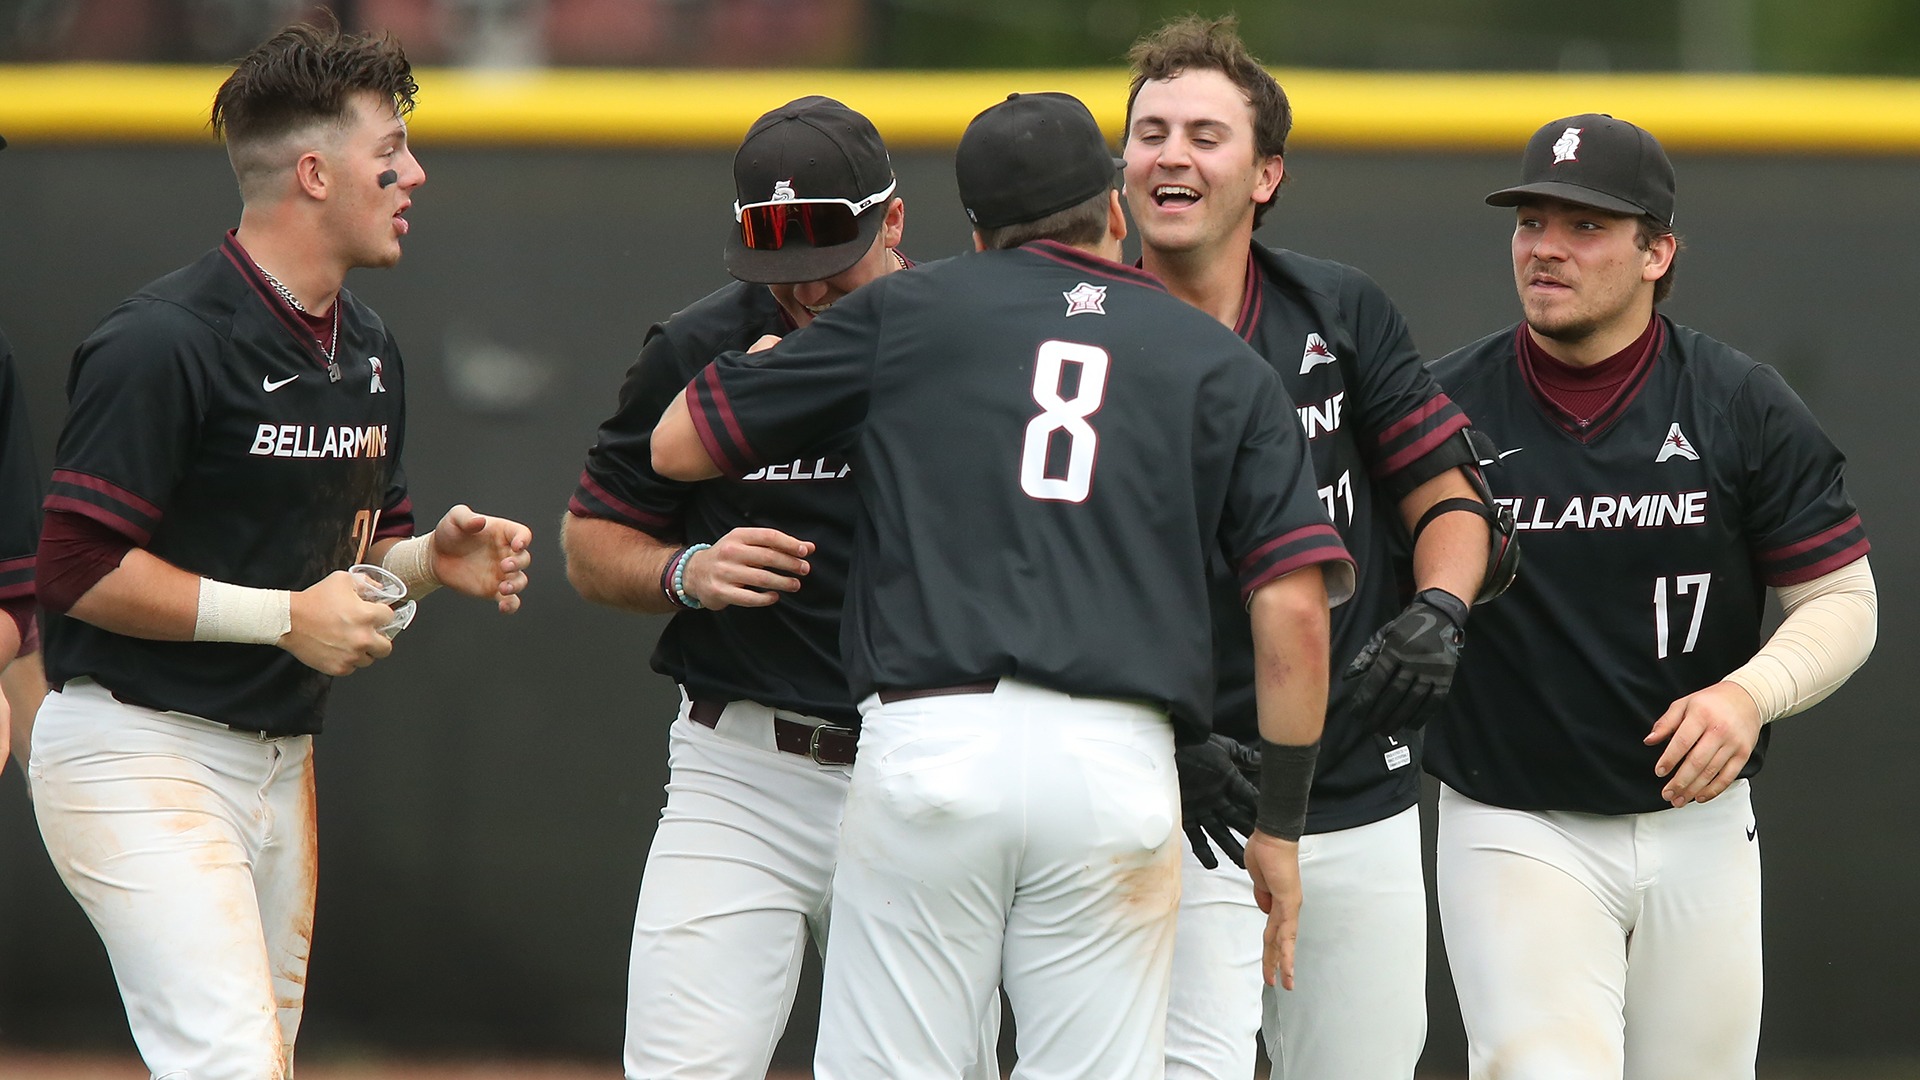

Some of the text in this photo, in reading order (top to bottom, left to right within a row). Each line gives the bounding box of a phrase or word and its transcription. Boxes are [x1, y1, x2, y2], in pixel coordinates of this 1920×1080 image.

[249, 423, 388, 458] BELLARMINE
[1019, 338, 1111, 504] 8
[1296, 390, 1345, 439] INE
[1317, 469, 1355, 528] 77
[351, 508, 382, 566] 2
[1653, 572, 1711, 660] 17
[1388, 735, 1399, 746] L
